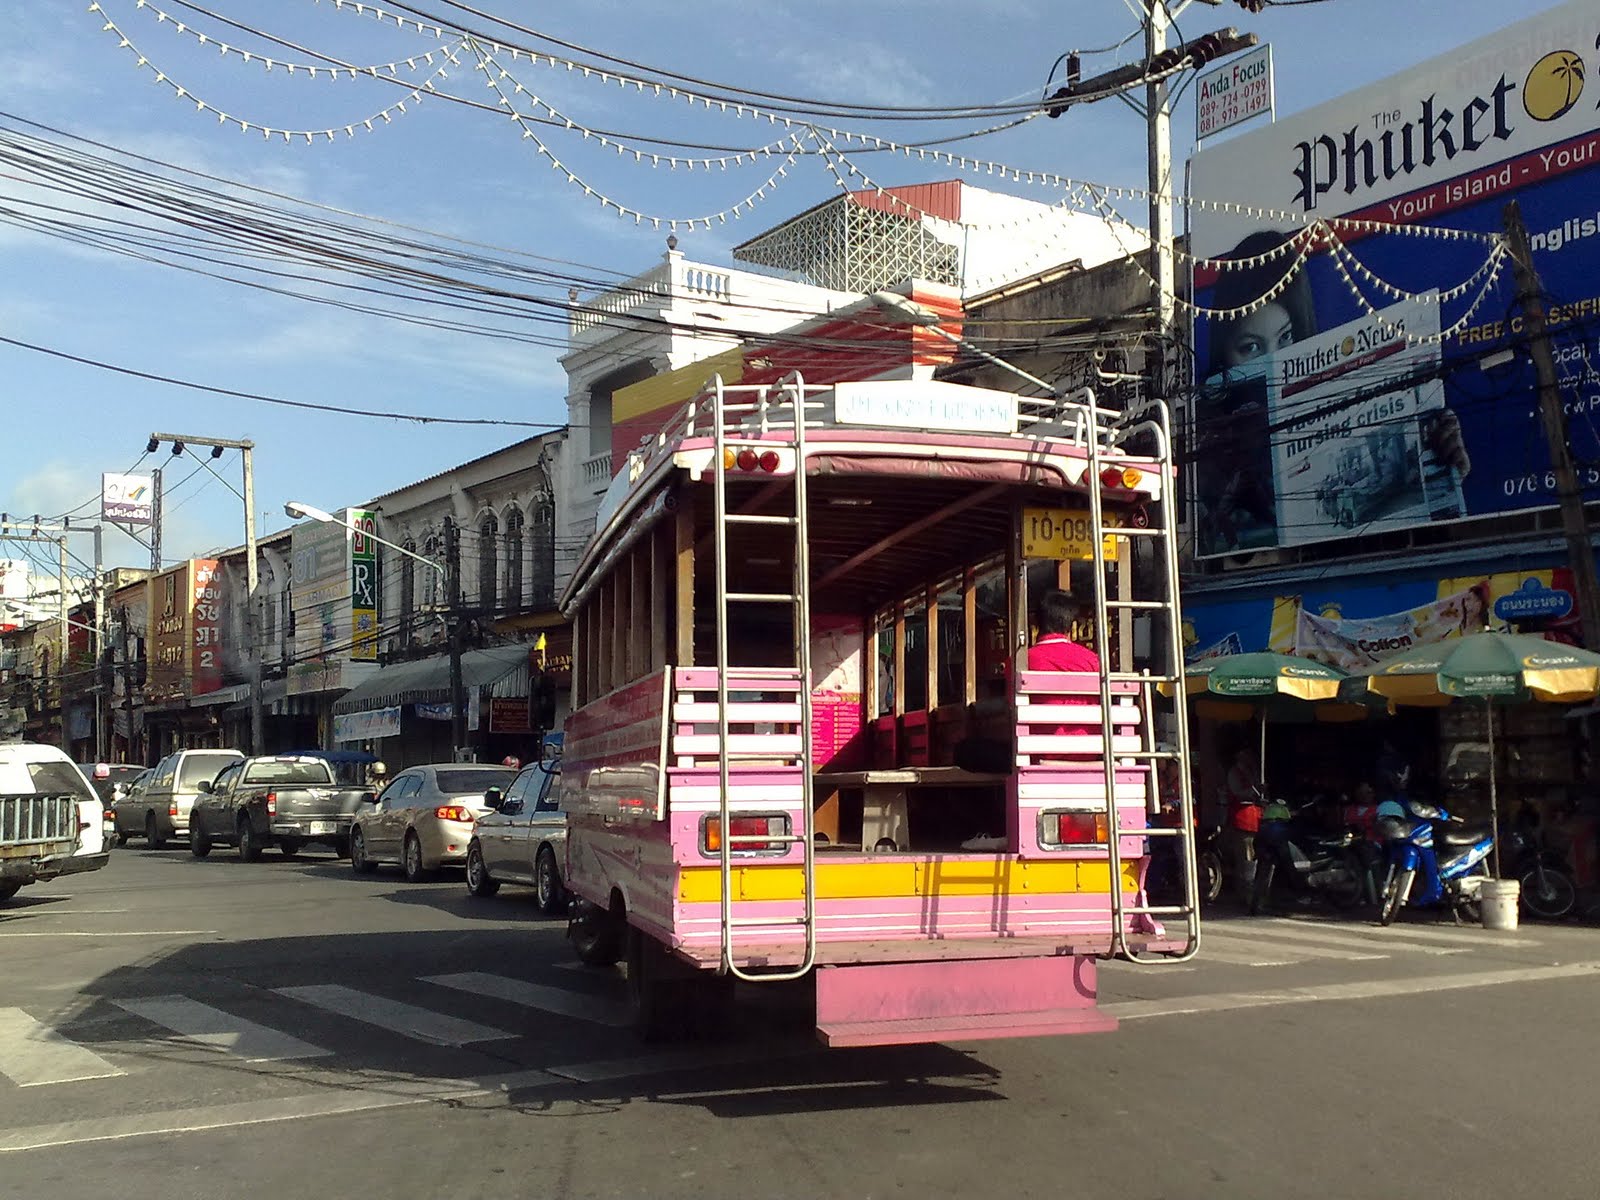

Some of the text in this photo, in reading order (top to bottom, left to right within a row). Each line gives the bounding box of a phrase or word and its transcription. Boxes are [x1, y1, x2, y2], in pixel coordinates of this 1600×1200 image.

[1201, 59, 1266, 102] Anda Focus
[1291, 72, 1516, 212] Phuket
[1372, 109, 1401, 129] The
[1389, 194, 1436, 220] Your
[1445, 164, 1511, 204] Island
[1540, 140, 1598, 172] Your
[1525, 211, 1600, 252] nglis
[1283, 318, 1405, 385] Phuket News
[1287, 397, 1405, 458] nursing crisis
[200, 651, 214, 668] 2
